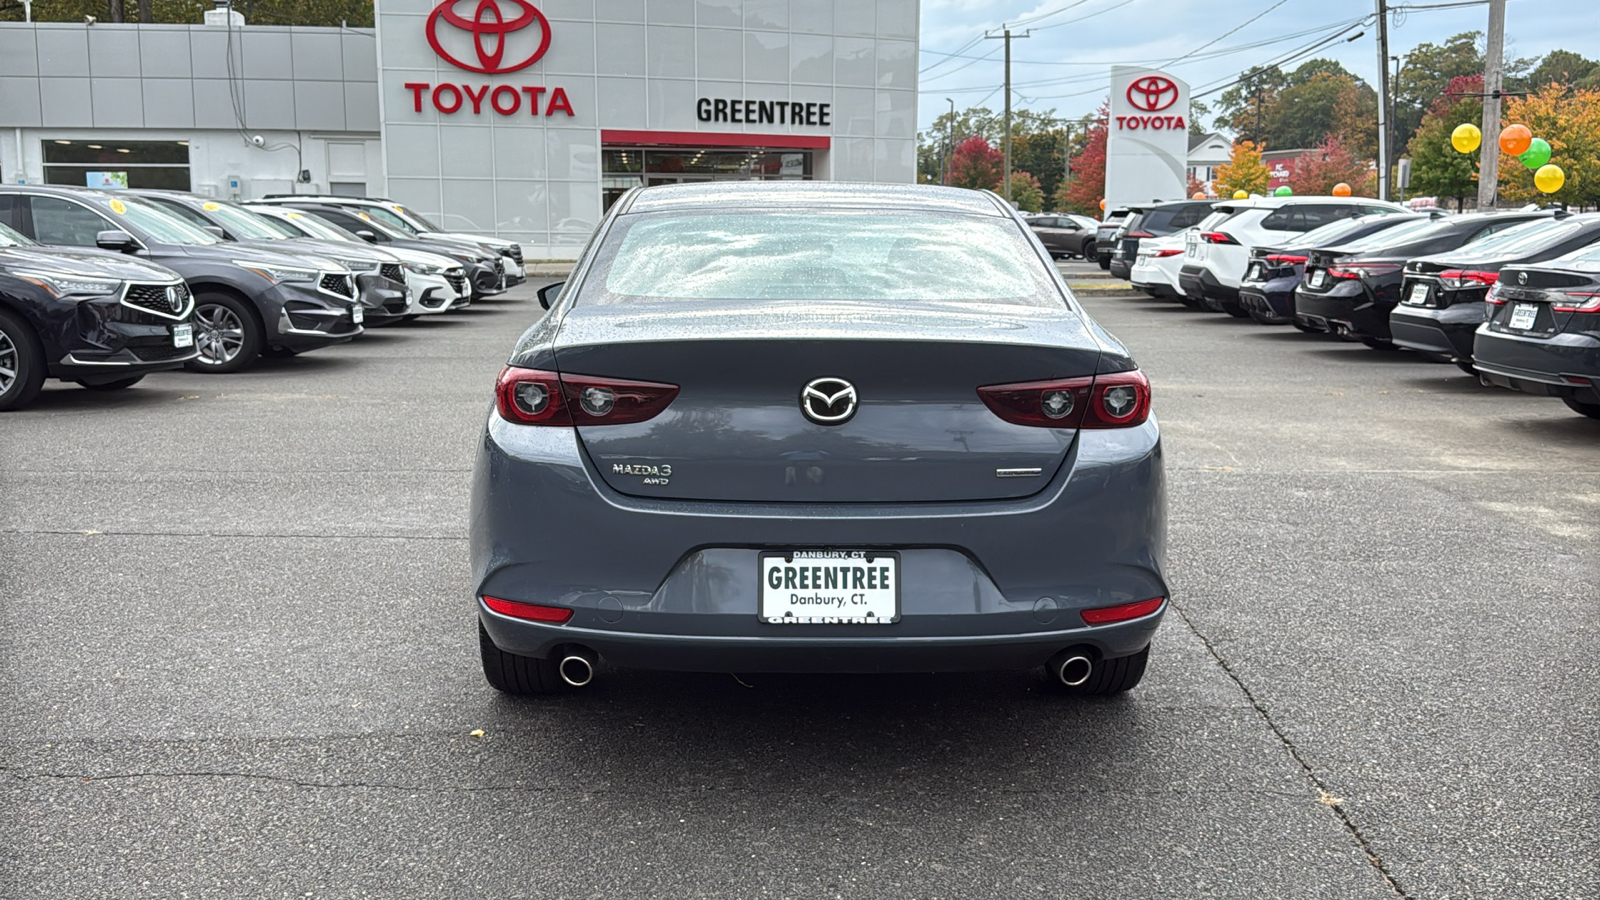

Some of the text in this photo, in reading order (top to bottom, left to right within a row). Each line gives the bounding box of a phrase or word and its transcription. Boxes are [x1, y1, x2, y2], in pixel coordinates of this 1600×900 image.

[404, 82, 575, 116] TOYOTA
[696, 97, 831, 126] GREENTREE
[1115, 115, 1186, 130] TOYOTA
[612, 463, 672, 476] MAZDA3
[642, 477, 669, 485] AWD
[793, 551, 866, 560] DANBURY, CT
[768, 566, 890, 590] GREENTREE
[790, 592, 868, 609] Danbury, CT.
